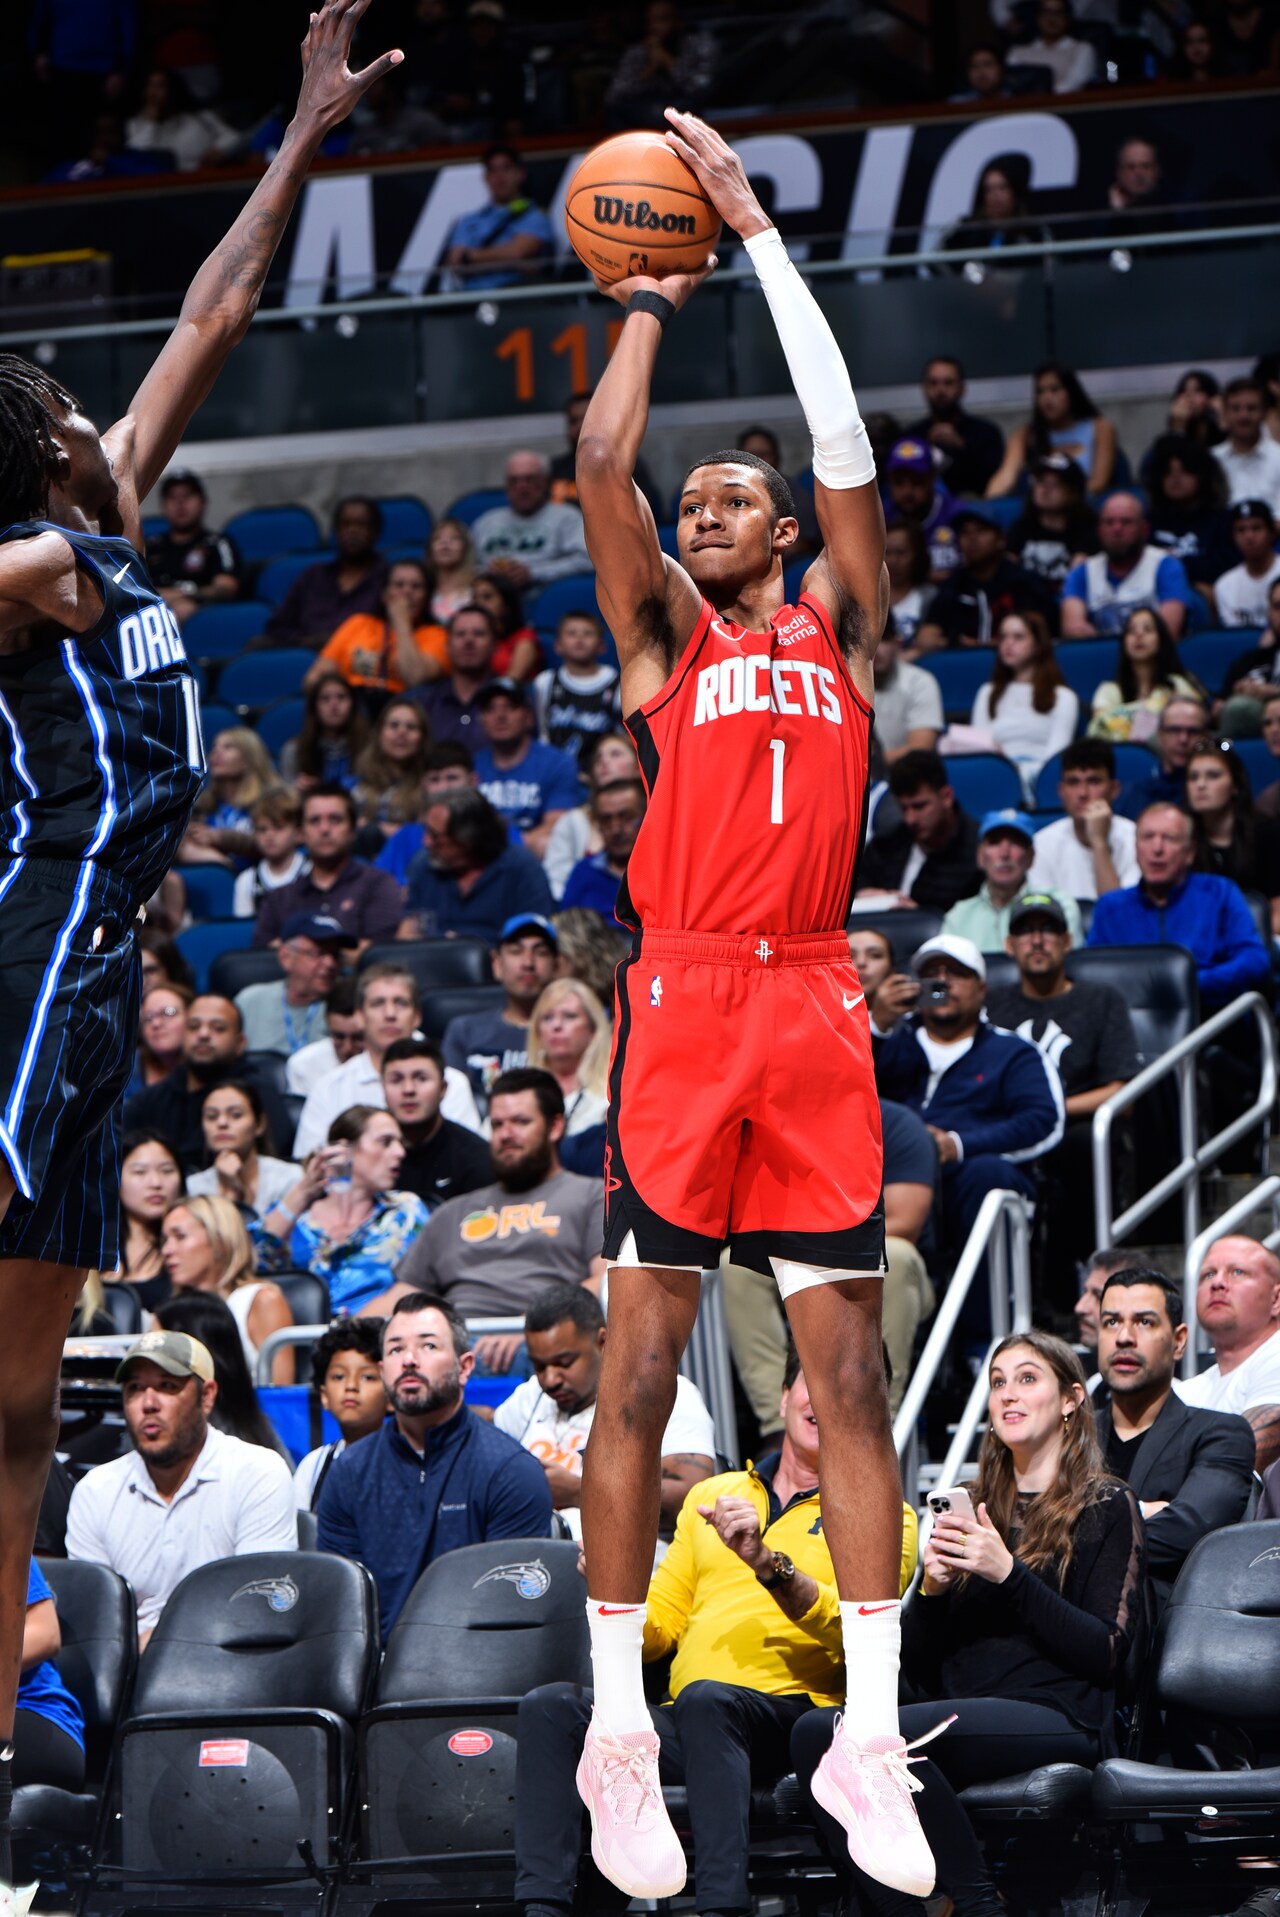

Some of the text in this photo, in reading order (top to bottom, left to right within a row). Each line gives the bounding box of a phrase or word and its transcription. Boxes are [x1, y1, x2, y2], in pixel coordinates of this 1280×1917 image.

[284, 113, 1079, 315] MIC
[593, 194, 697, 235] Wilson
[496, 319, 626, 401] 11
[119, 600, 187, 681] ORL
[776, 614, 809, 637] redit
[181, 675, 208, 774] 1
[769, 738, 786, 824] 1
